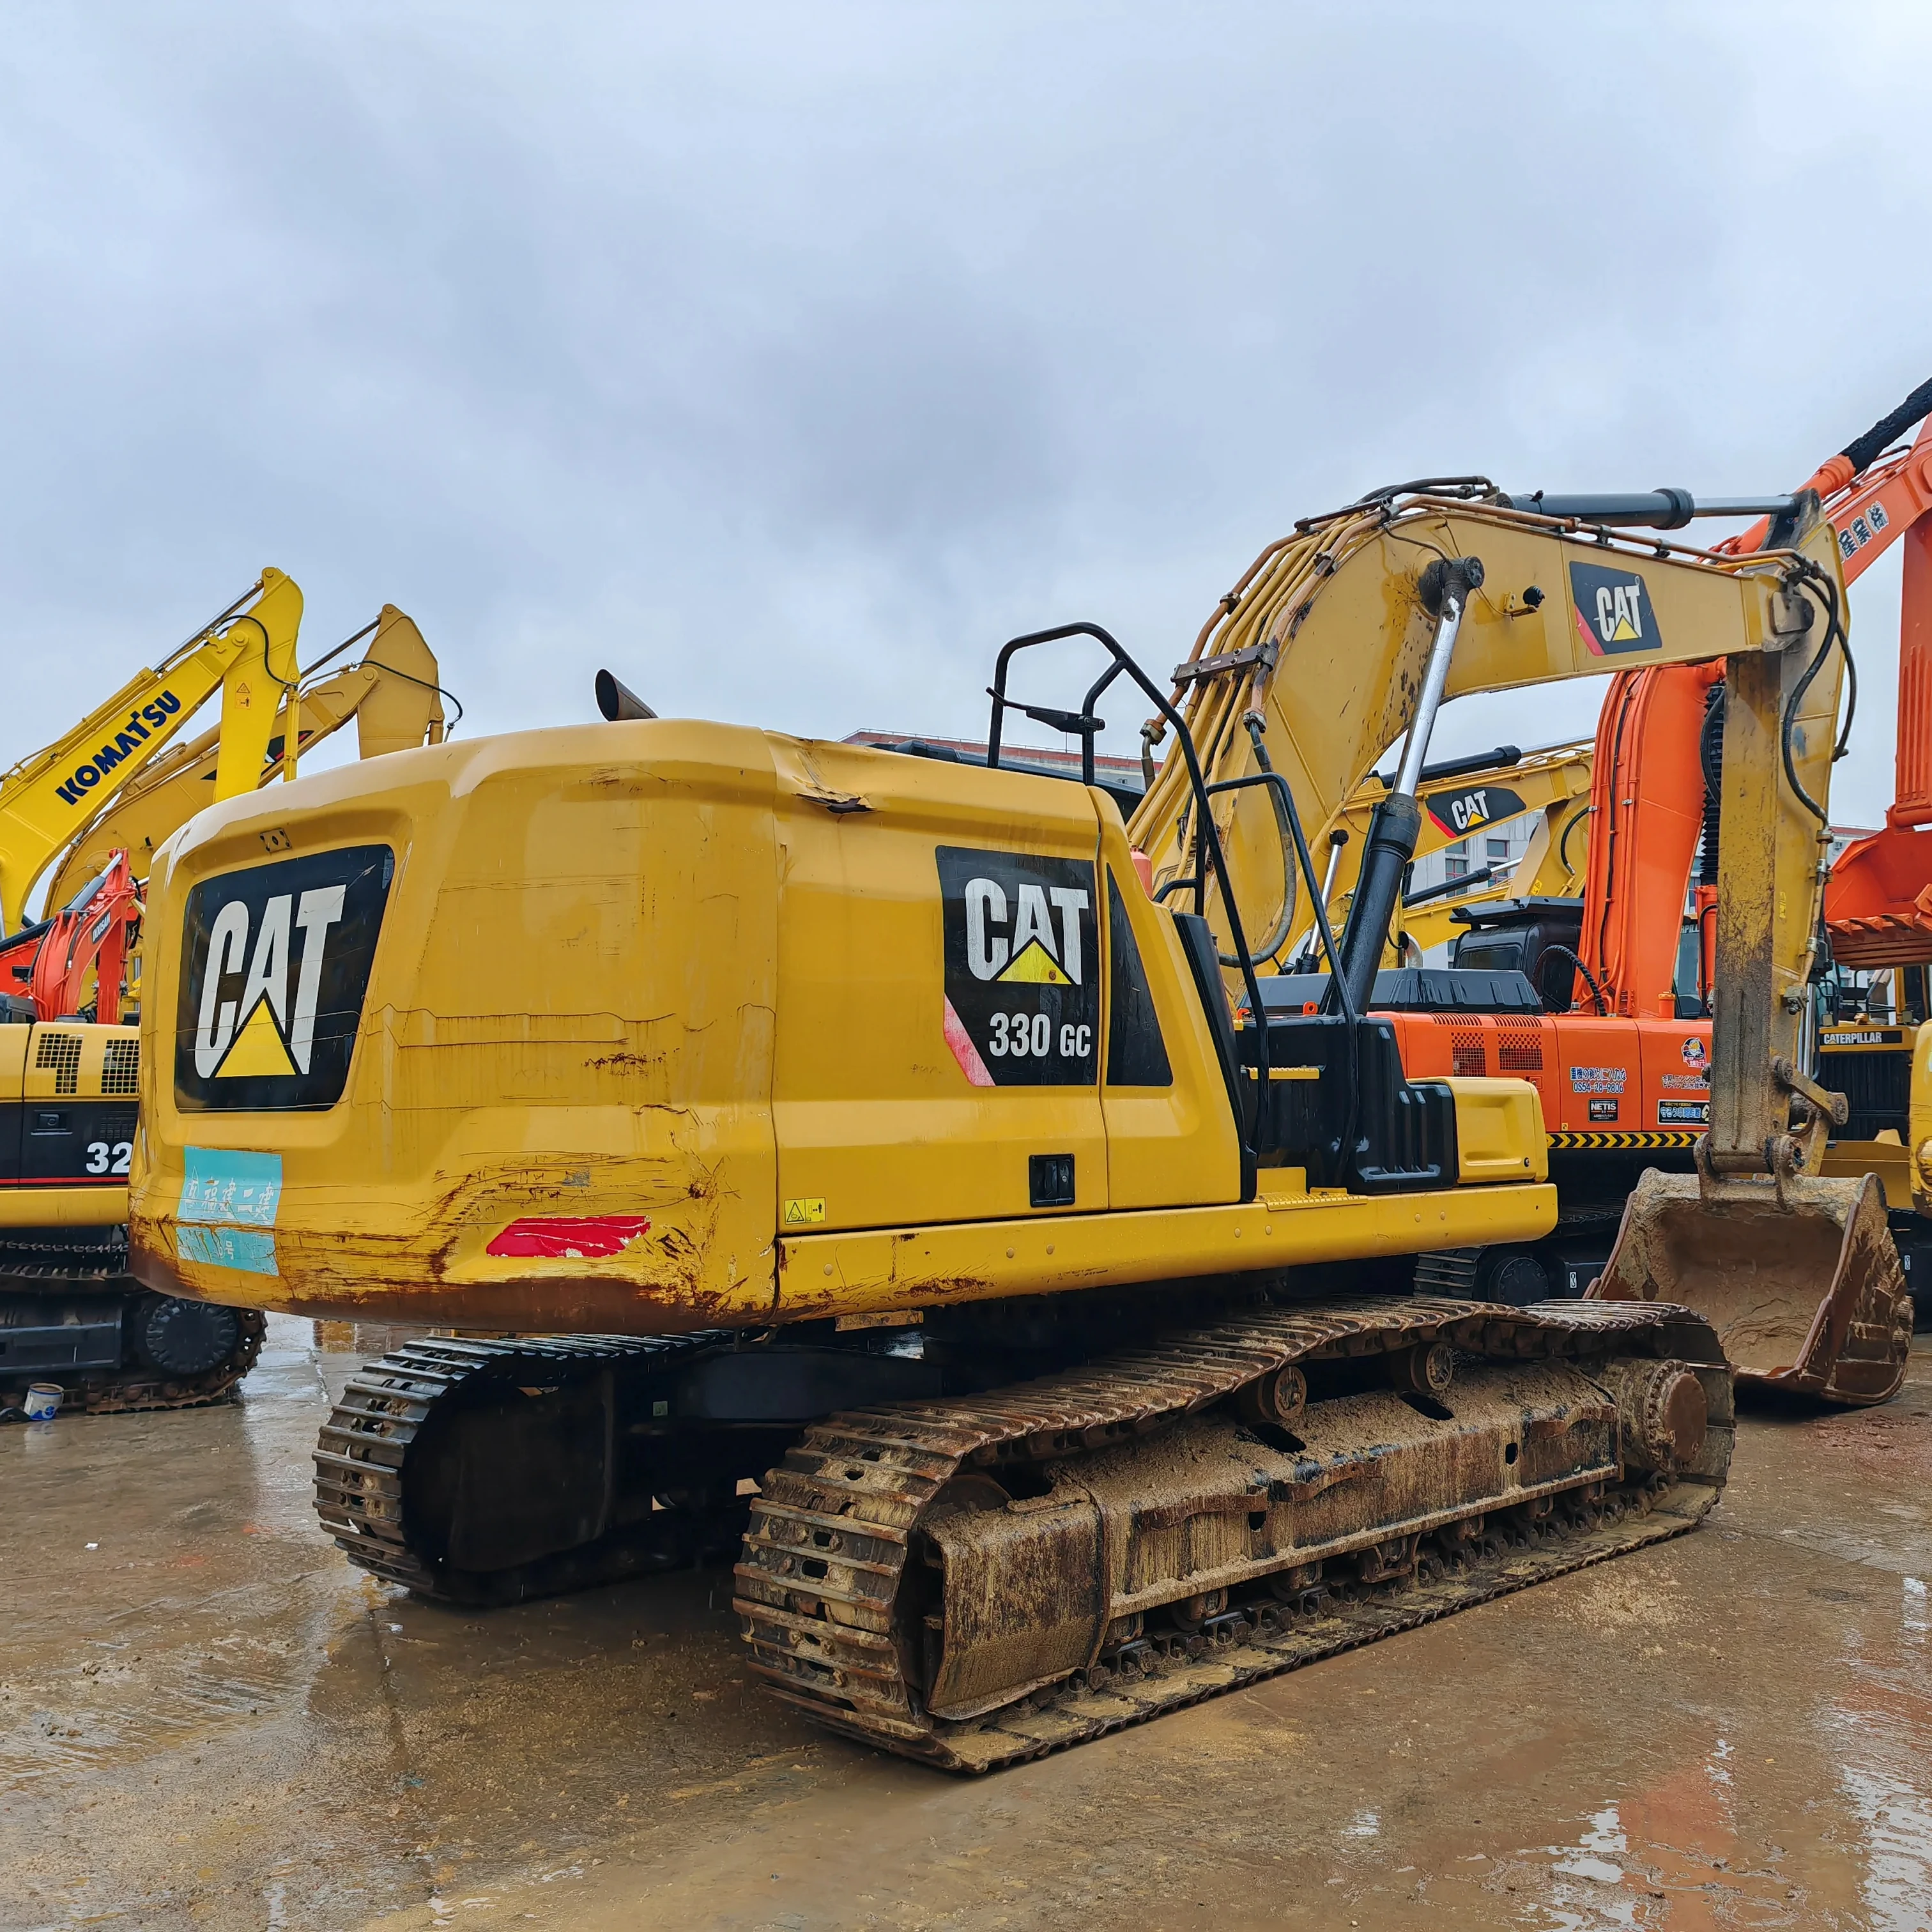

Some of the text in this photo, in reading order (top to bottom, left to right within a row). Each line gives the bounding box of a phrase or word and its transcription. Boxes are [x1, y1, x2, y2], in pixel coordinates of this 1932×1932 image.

[1596, 585, 1643, 641] CAT
[55, 690, 181, 806] KOMATSU
[1451, 790, 1490, 829] CAT
[965, 878, 1089, 985] CAT
[195, 884, 346, 1078] CAT
[989, 1013, 1091, 1057] 330 GC
[1823, 1032, 1882, 1045] CATERPILLAR
[86, 1142, 133, 1174] 32
